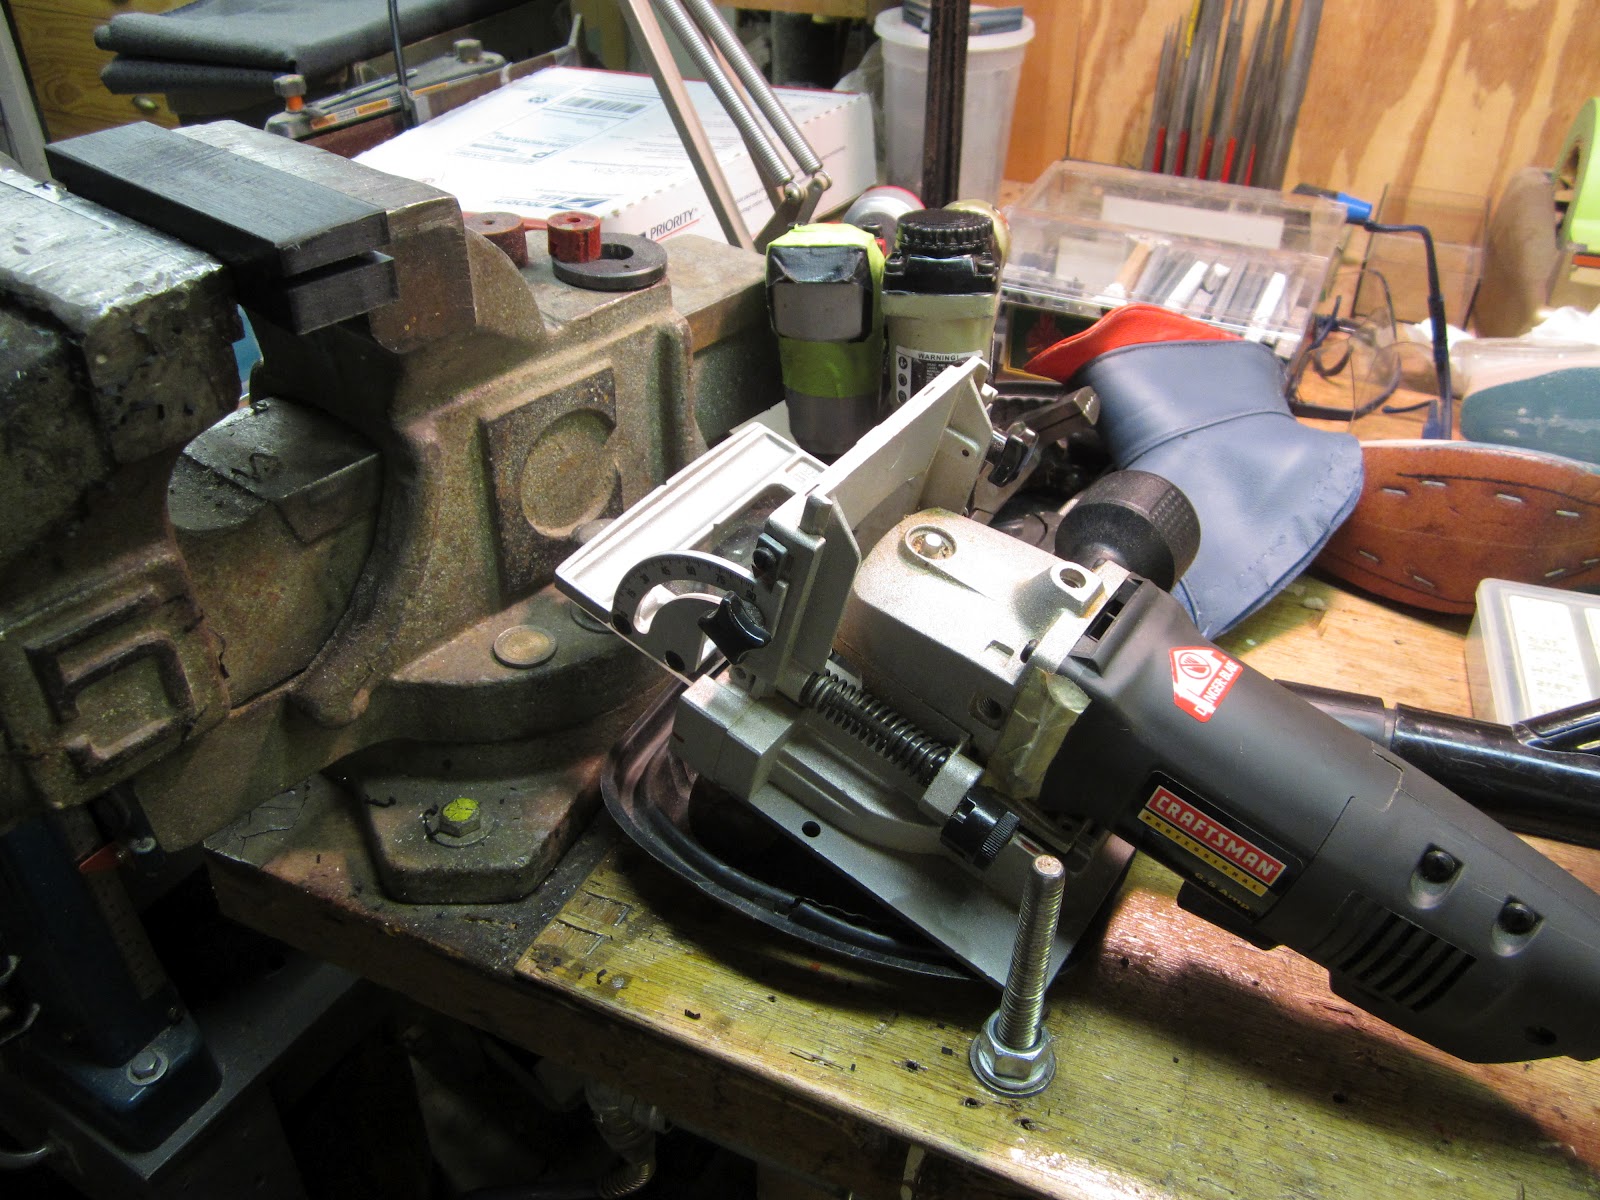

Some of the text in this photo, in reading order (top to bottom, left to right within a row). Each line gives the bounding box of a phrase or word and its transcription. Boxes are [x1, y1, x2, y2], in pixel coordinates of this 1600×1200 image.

[650, 207, 695, 240] PRIORITY
[918, 352, 960, 361] WARNING!
[715, 572, 727, 585] 75
[1194, 677, 1229, 717] DNGER:
[1144, 815, 1259, 890] PROFESSIONAL
[1155, 795, 1276, 878] CRAFTSMAN
